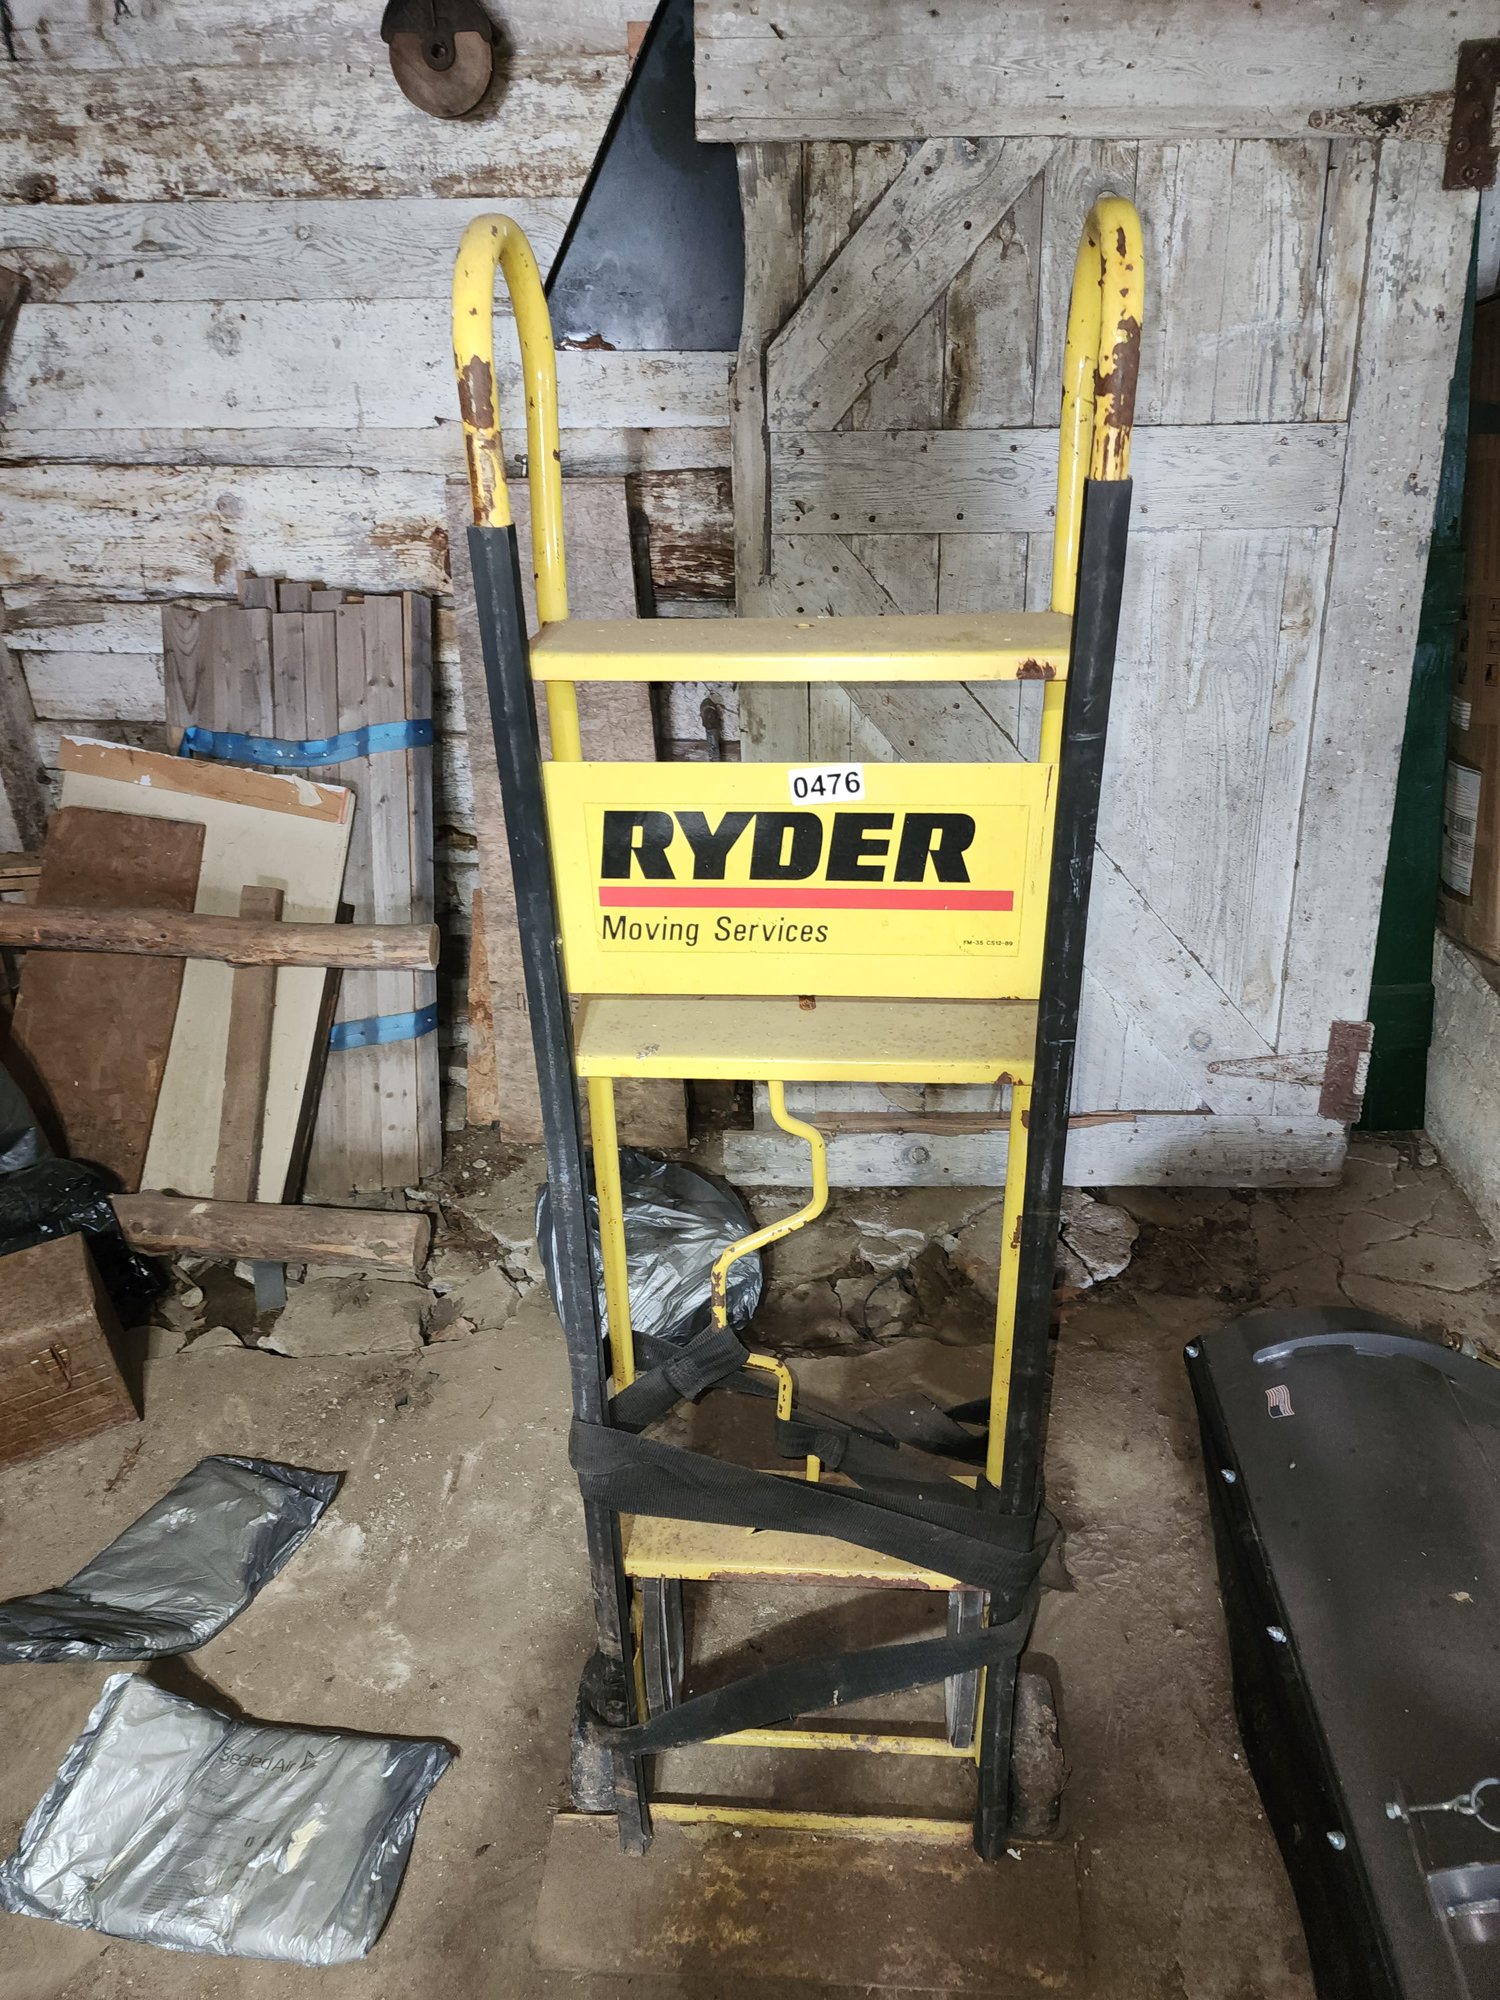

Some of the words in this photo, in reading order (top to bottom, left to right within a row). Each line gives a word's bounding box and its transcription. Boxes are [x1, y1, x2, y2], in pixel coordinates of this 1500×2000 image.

[792, 771, 861, 798] 0476
[600, 810, 976, 883] RYDER
[602, 914, 699, 947] Moving
[714, 915, 828, 943] Services
[219, 1746, 271, 1770] Sealed
[271, 1757, 297, 1773] Air
